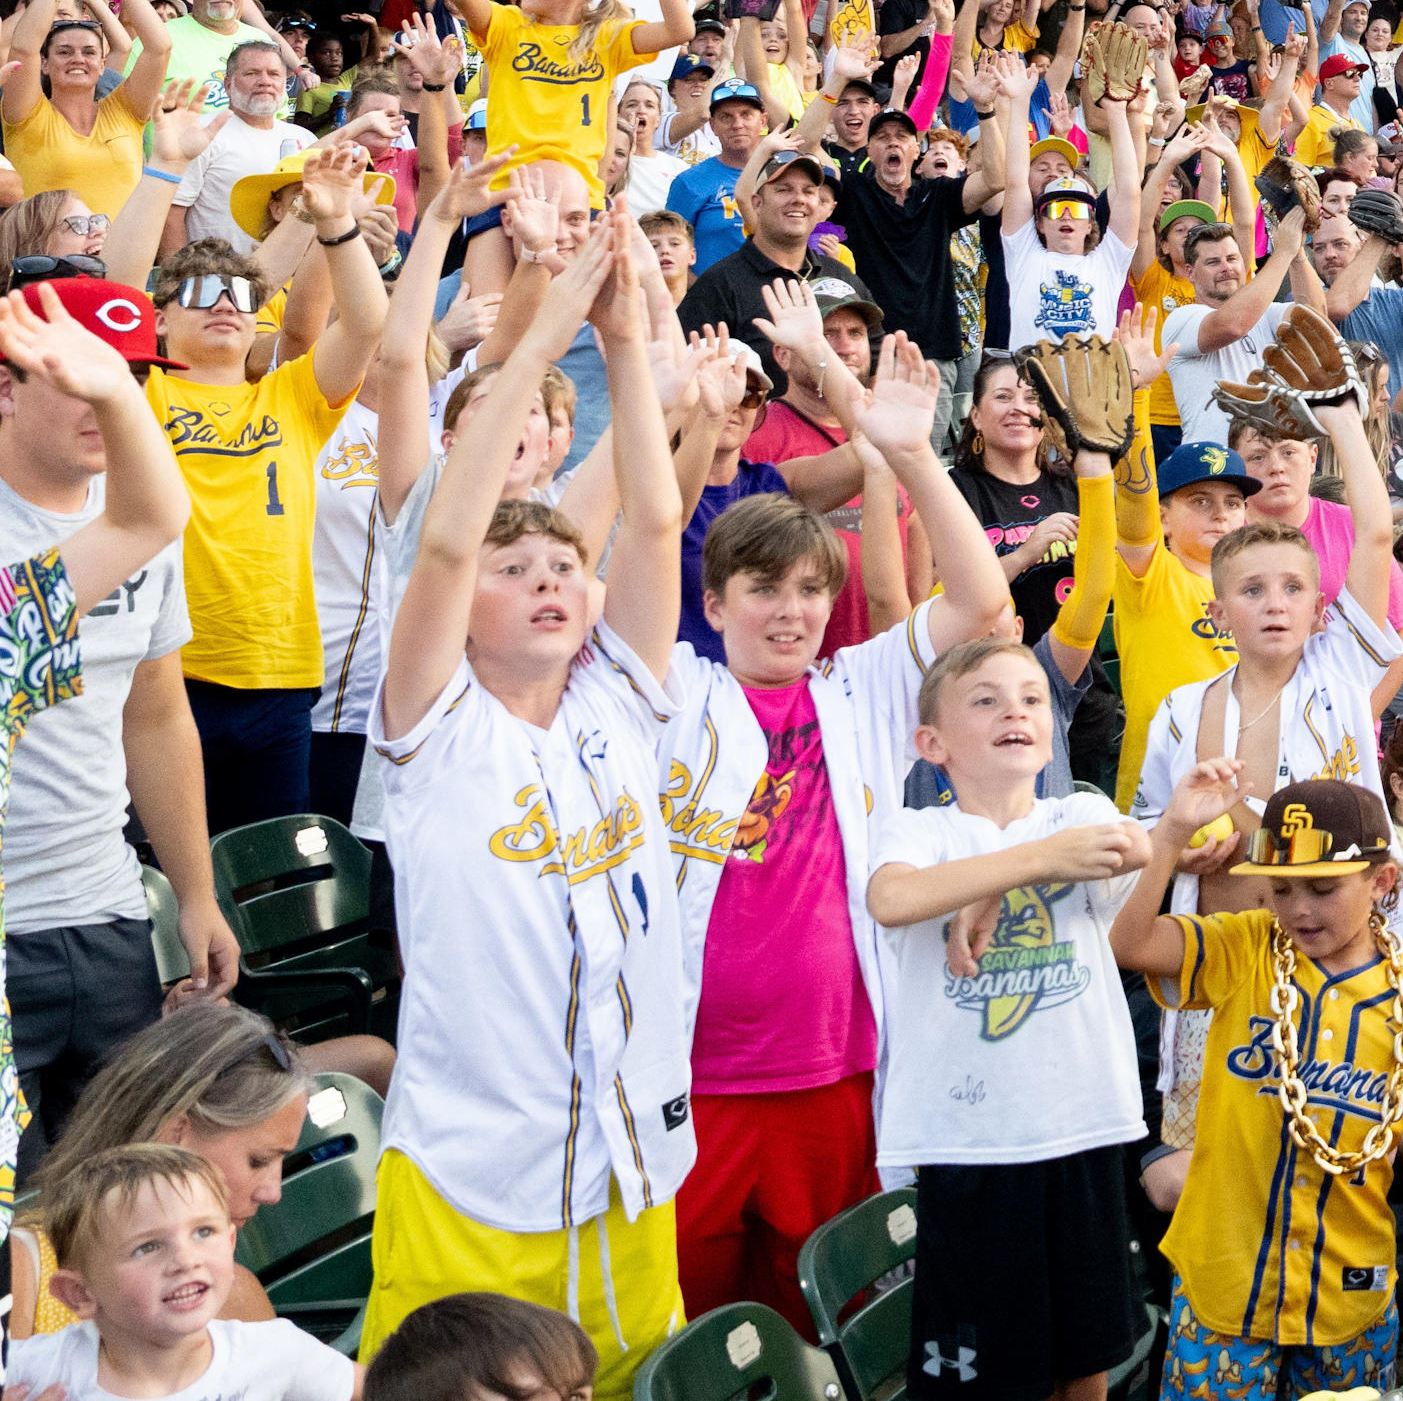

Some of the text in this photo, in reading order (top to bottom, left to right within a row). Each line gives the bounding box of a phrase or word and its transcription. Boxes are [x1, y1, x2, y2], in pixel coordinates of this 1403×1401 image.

[580, 93, 594, 127] 1
[95, 298, 142, 333] C
[1052, 307, 1085, 321] CITY
[266, 461, 285, 516] 1
[980, 941, 1078, 975] SAVANNAH
